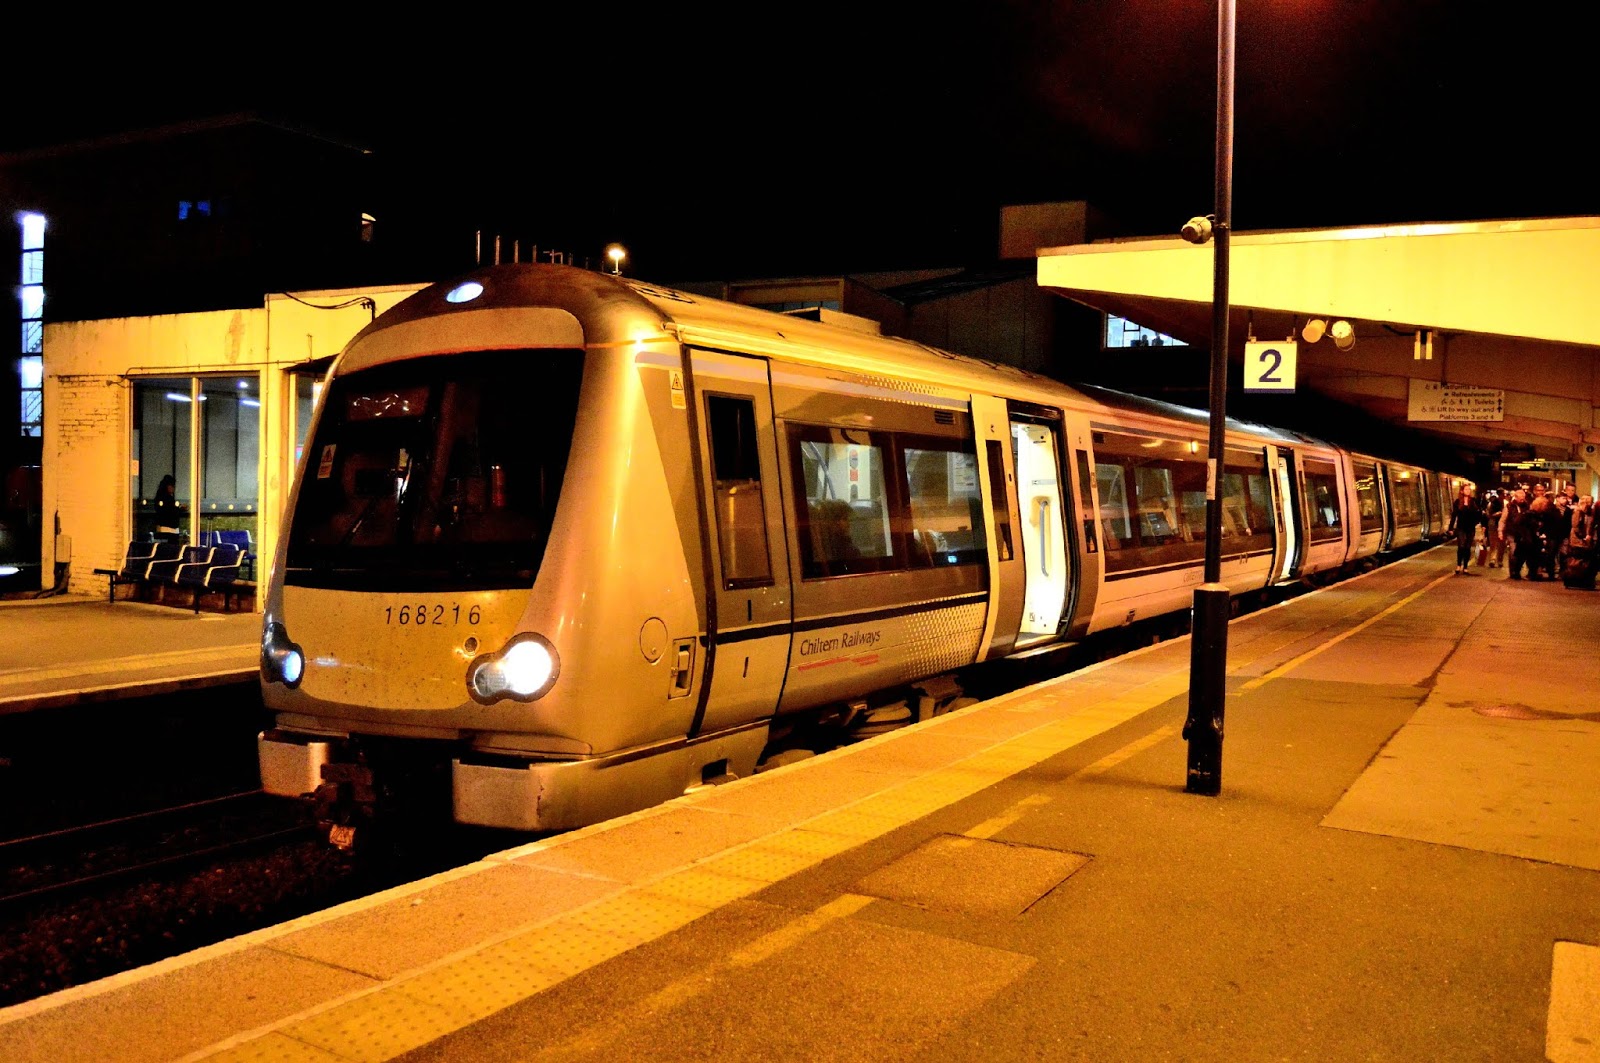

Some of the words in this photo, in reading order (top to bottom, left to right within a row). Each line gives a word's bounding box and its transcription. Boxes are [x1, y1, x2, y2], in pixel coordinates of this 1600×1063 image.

[1258, 348, 1282, 383] 2
[385, 604, 480, 625] 168216
[800, 637, 839, 656] Chiltern
[841, 630, 881, 648] Railways
